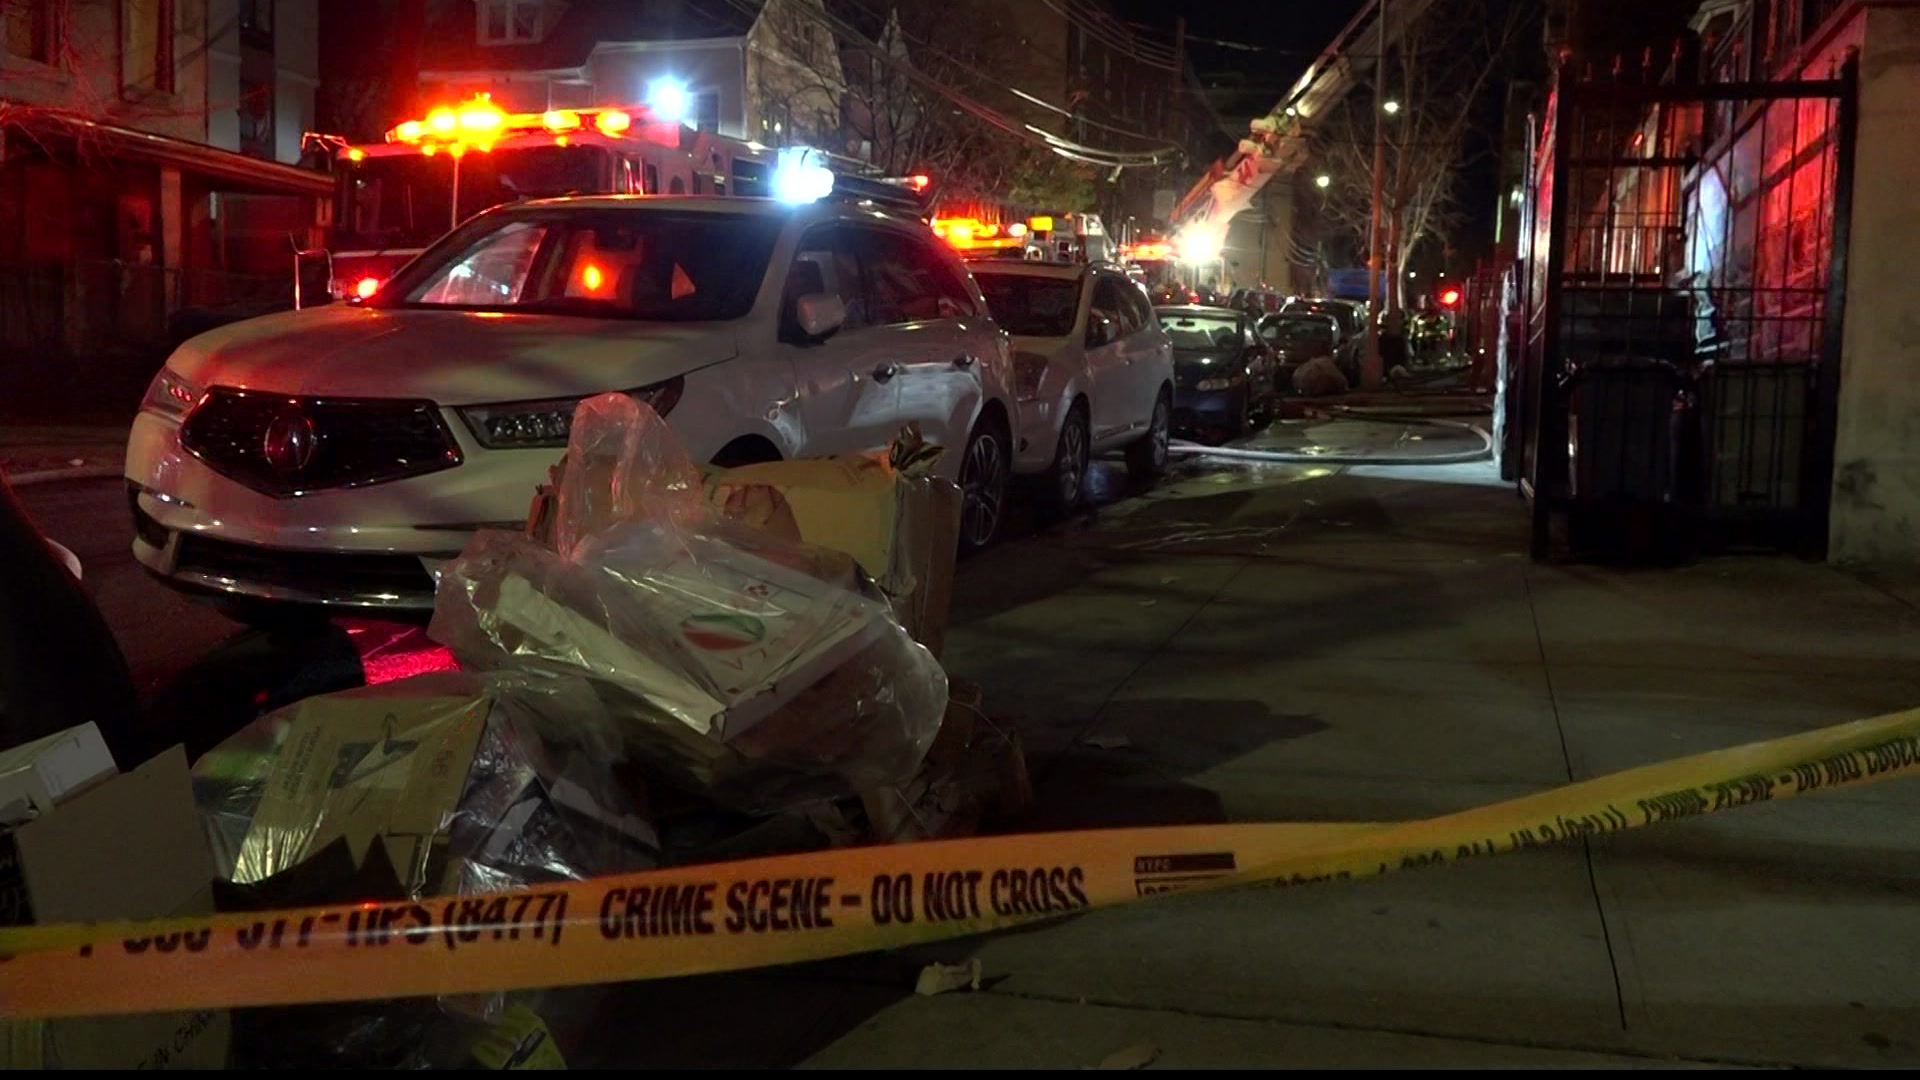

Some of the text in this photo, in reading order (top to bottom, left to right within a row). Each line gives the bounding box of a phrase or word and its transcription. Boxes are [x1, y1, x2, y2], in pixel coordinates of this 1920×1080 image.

[443, 891, 569, 949] (8477)
[600, 883, 718, 940] CRIME
[725, 876, 836, 932] SCENE
[871, 873, 915, 926] DO
[923, 867, 982, 922] NOT
[990, 865, 1089, 918] CROSS
